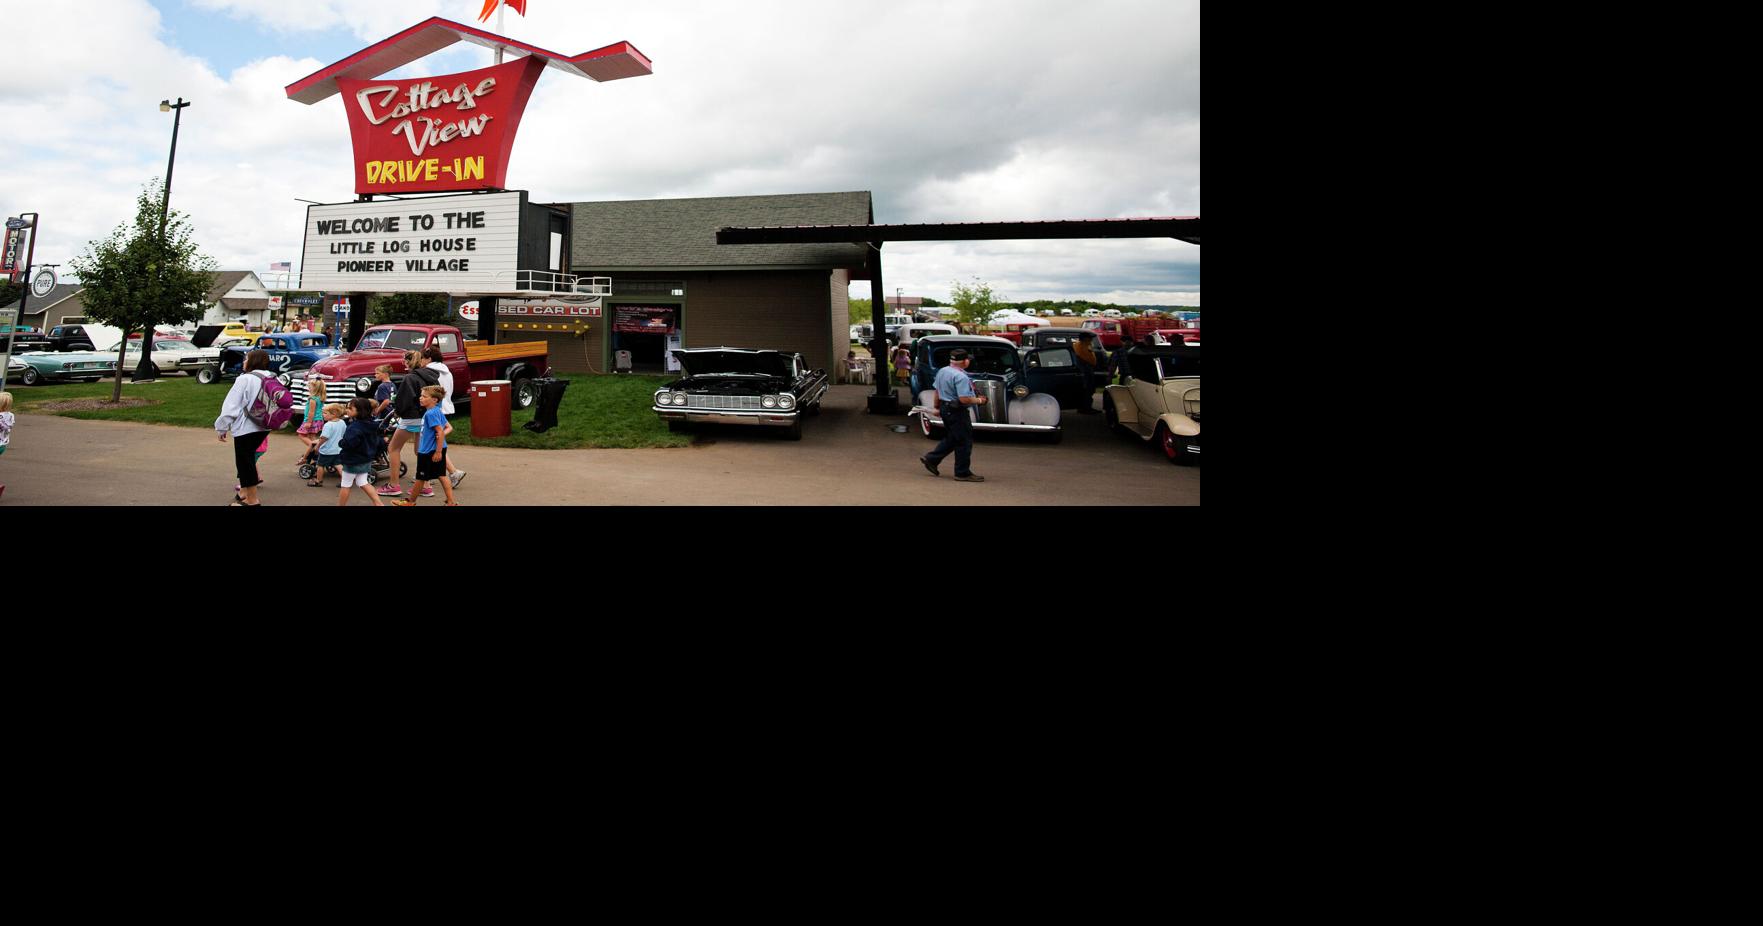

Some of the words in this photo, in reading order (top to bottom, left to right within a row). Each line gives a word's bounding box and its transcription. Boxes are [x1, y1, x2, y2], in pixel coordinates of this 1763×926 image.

[356, 77, 497, 125] Cottage
[391, 113, 494, 156] View
[366, 155, 485, 184] DRIVE-IN
[316, 216, 400, 236] WELCOME
[409, 214, 434, 232] TO
[443, 210, 486, 230] THE
[330, 242, 375, 255] LITTLE
[382, 240, 410, 254] LOG
[420, 238, 477, 253] HOUSE
[337, 261, 394, 273] PIONEER
[405, 258, 470, 272] VILLAGE
[36, 279, 51, 288] PURE
[495, 304, 528, 314] SED
[532, 305, 565, 315] CAR
[570, 306, 600, 315] LOT
[279, 354, 292, 372] 2
